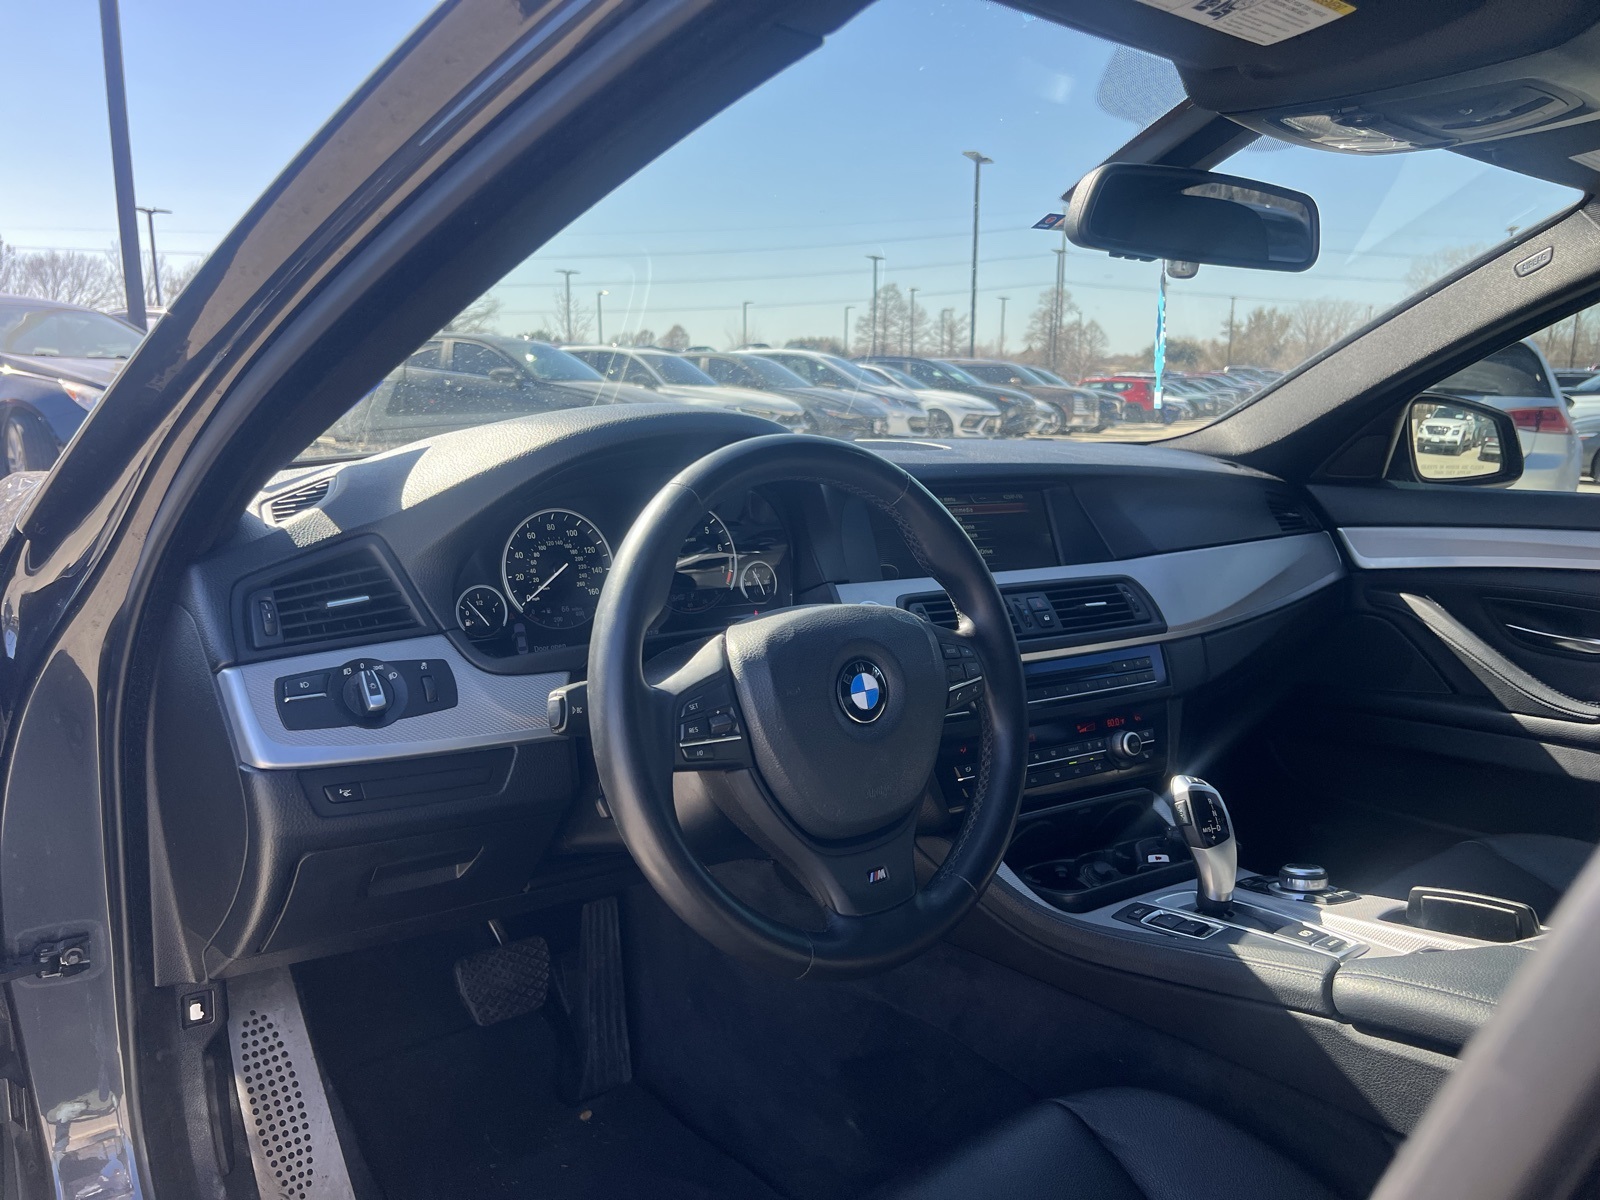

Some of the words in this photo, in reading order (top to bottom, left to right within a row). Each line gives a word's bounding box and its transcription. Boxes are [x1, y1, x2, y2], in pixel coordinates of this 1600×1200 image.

[546, 523, 556, 531] 80
[704, 526, 709, 534] 5
[566, 529, 578, 537] 100
[584, 546, 595, 554] 120
[717, 544, 722, 552] 6
[514, 551, 523, 559] 40
[591, 566, 603, 574] 140
[721, 566, 725, 574] 7
[515, 573, 524, 581] 20
[588, 587, 599, 595] 160
[534, 645, 550, 653] Door
[550, 643, 567, 652] open
[843, 662, 880, 685] BMW
[688, 702, 699, 711] SET
[688, 726, 699, 734] RES
